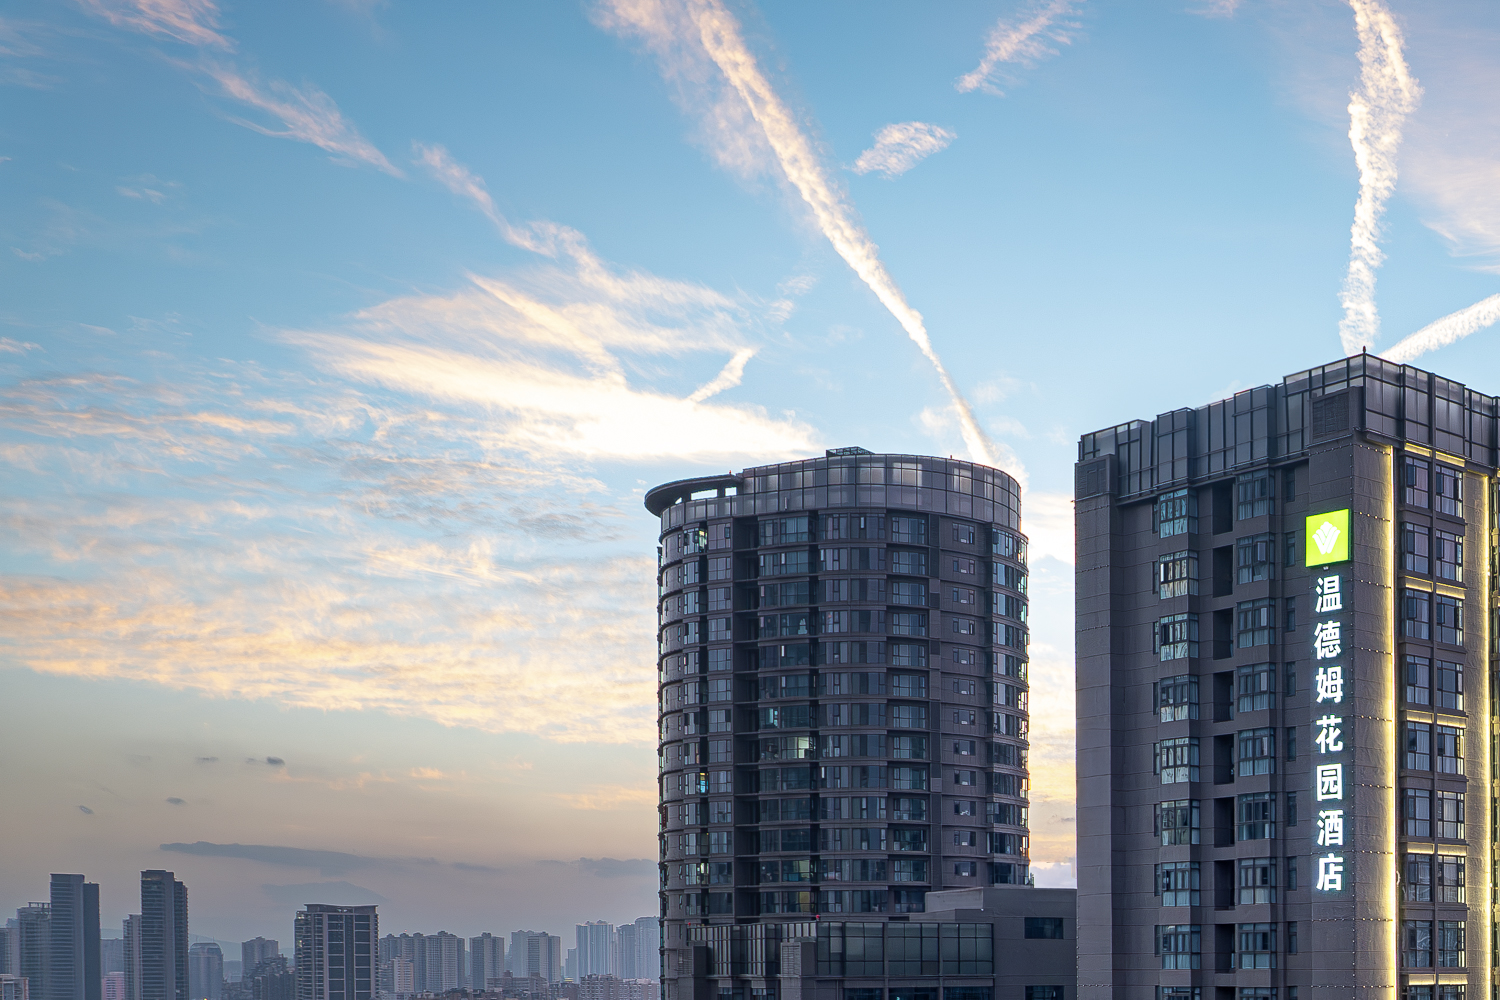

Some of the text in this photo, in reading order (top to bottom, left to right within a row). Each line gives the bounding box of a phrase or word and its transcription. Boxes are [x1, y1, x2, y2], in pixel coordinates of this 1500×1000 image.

[1313, 575, 1343, 891] 温德姆花园酒店
